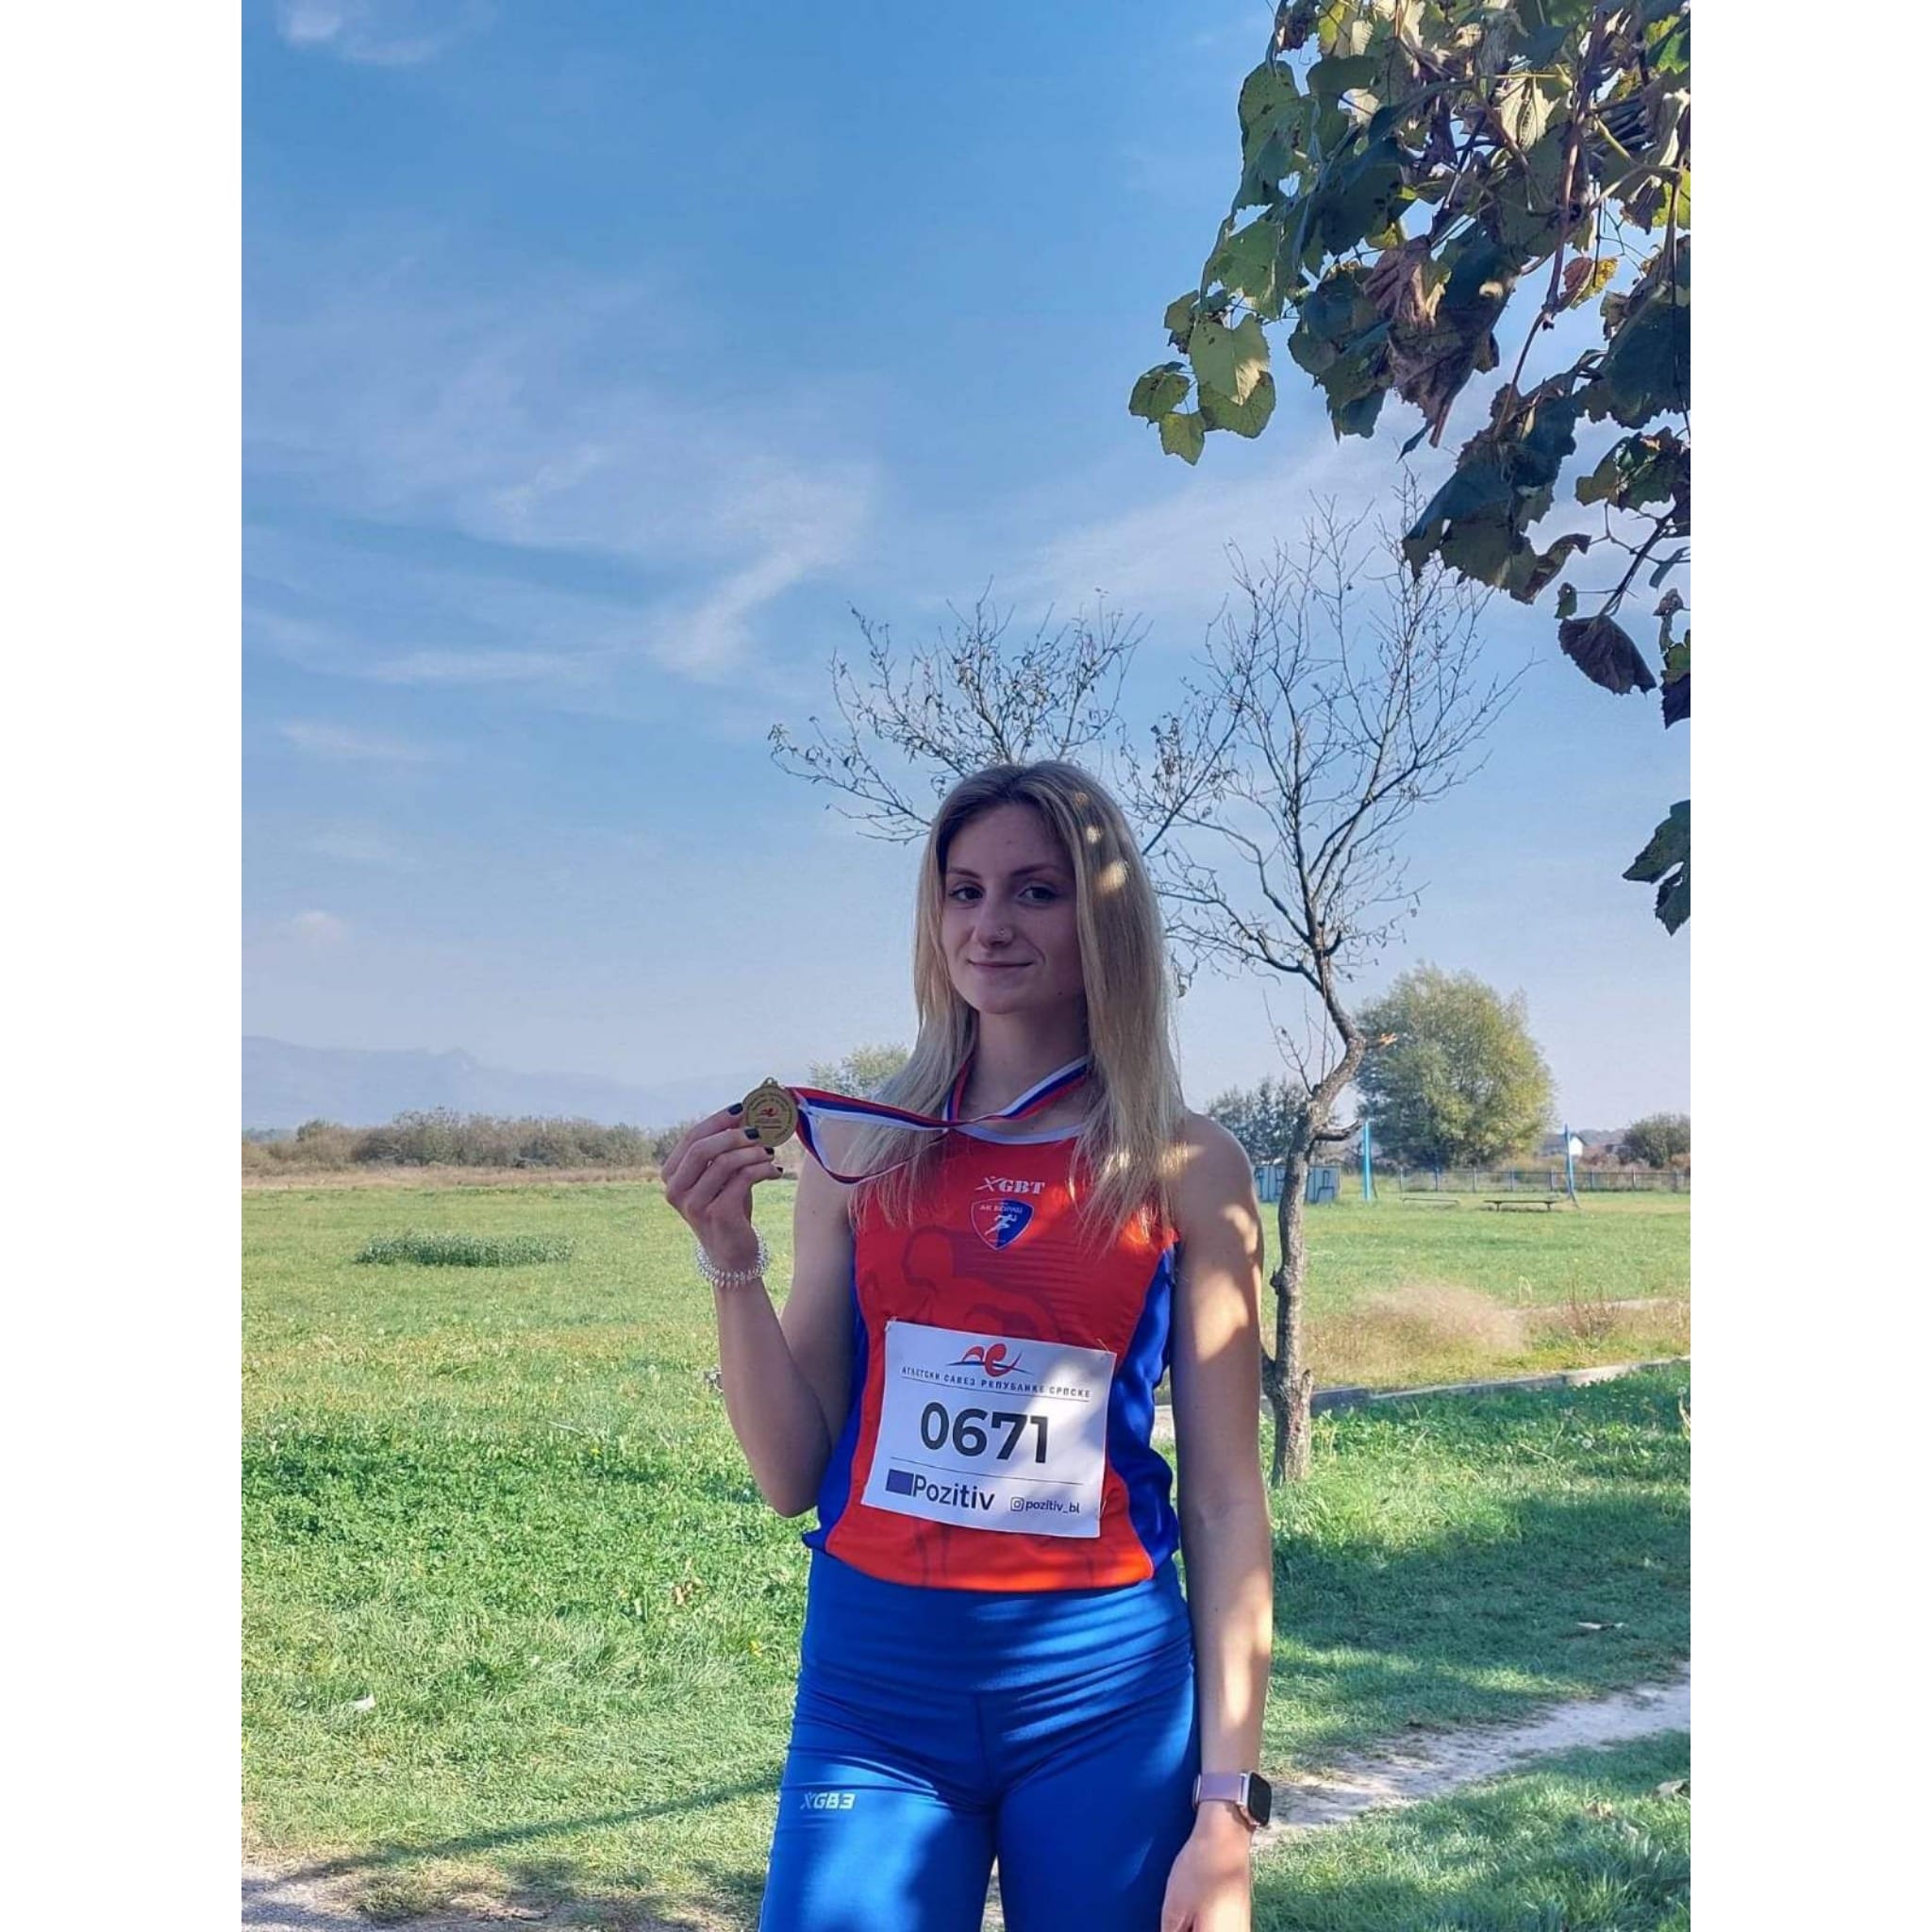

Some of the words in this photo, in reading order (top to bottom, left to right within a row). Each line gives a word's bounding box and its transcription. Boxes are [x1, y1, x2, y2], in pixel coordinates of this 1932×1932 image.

[920, 1401, 1049, 1464] 0671
[912, 1474, 995, 1510] Pozitiv
[1025, 1499, 1080, 1514] pozitiv_bl
